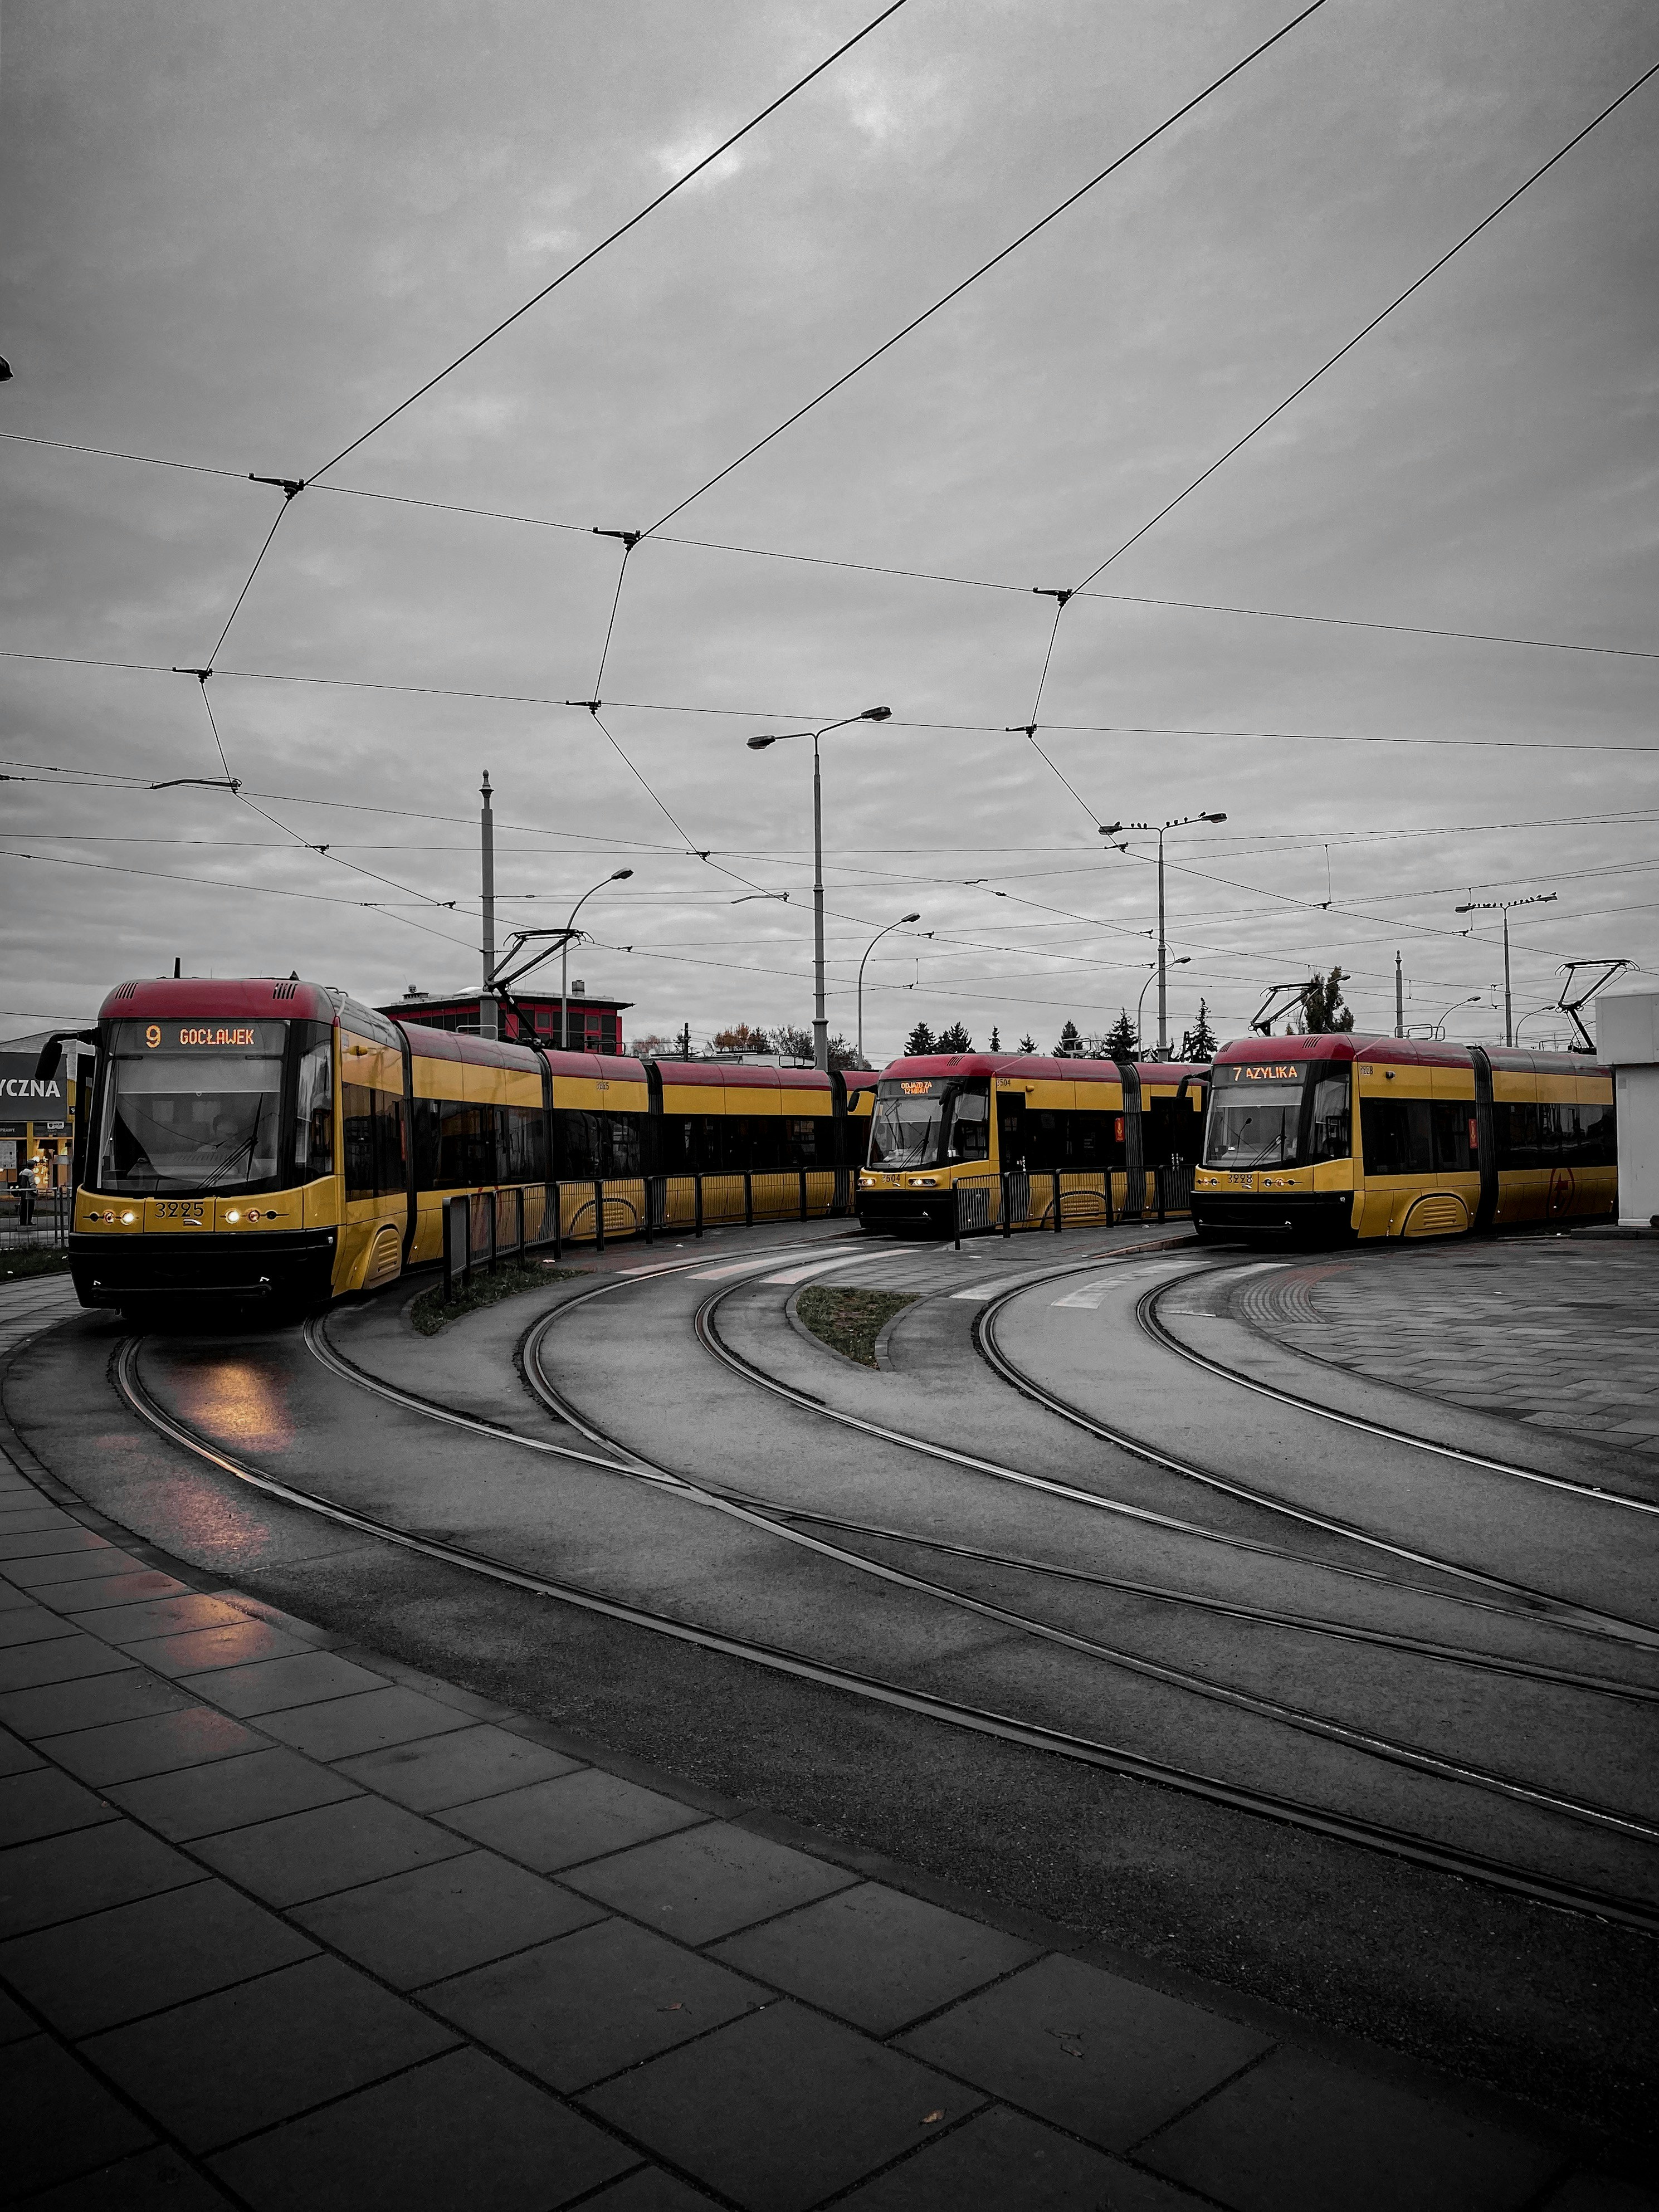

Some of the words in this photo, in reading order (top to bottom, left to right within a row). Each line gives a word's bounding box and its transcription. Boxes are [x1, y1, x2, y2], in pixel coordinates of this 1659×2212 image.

[145, 1024, 162, 1048] 9
[179, 1028, 255, 1045] GOCŁAWEK
[1233, 1067, 1242, 1081] 7
[1246, 1066, 1298, 1079] AZYLIKA
[881, 1174, 900, 1183] 3504
[1227, 1174, 1252, 1184] 3228
[154, 1202, 204, 1218] 3225
